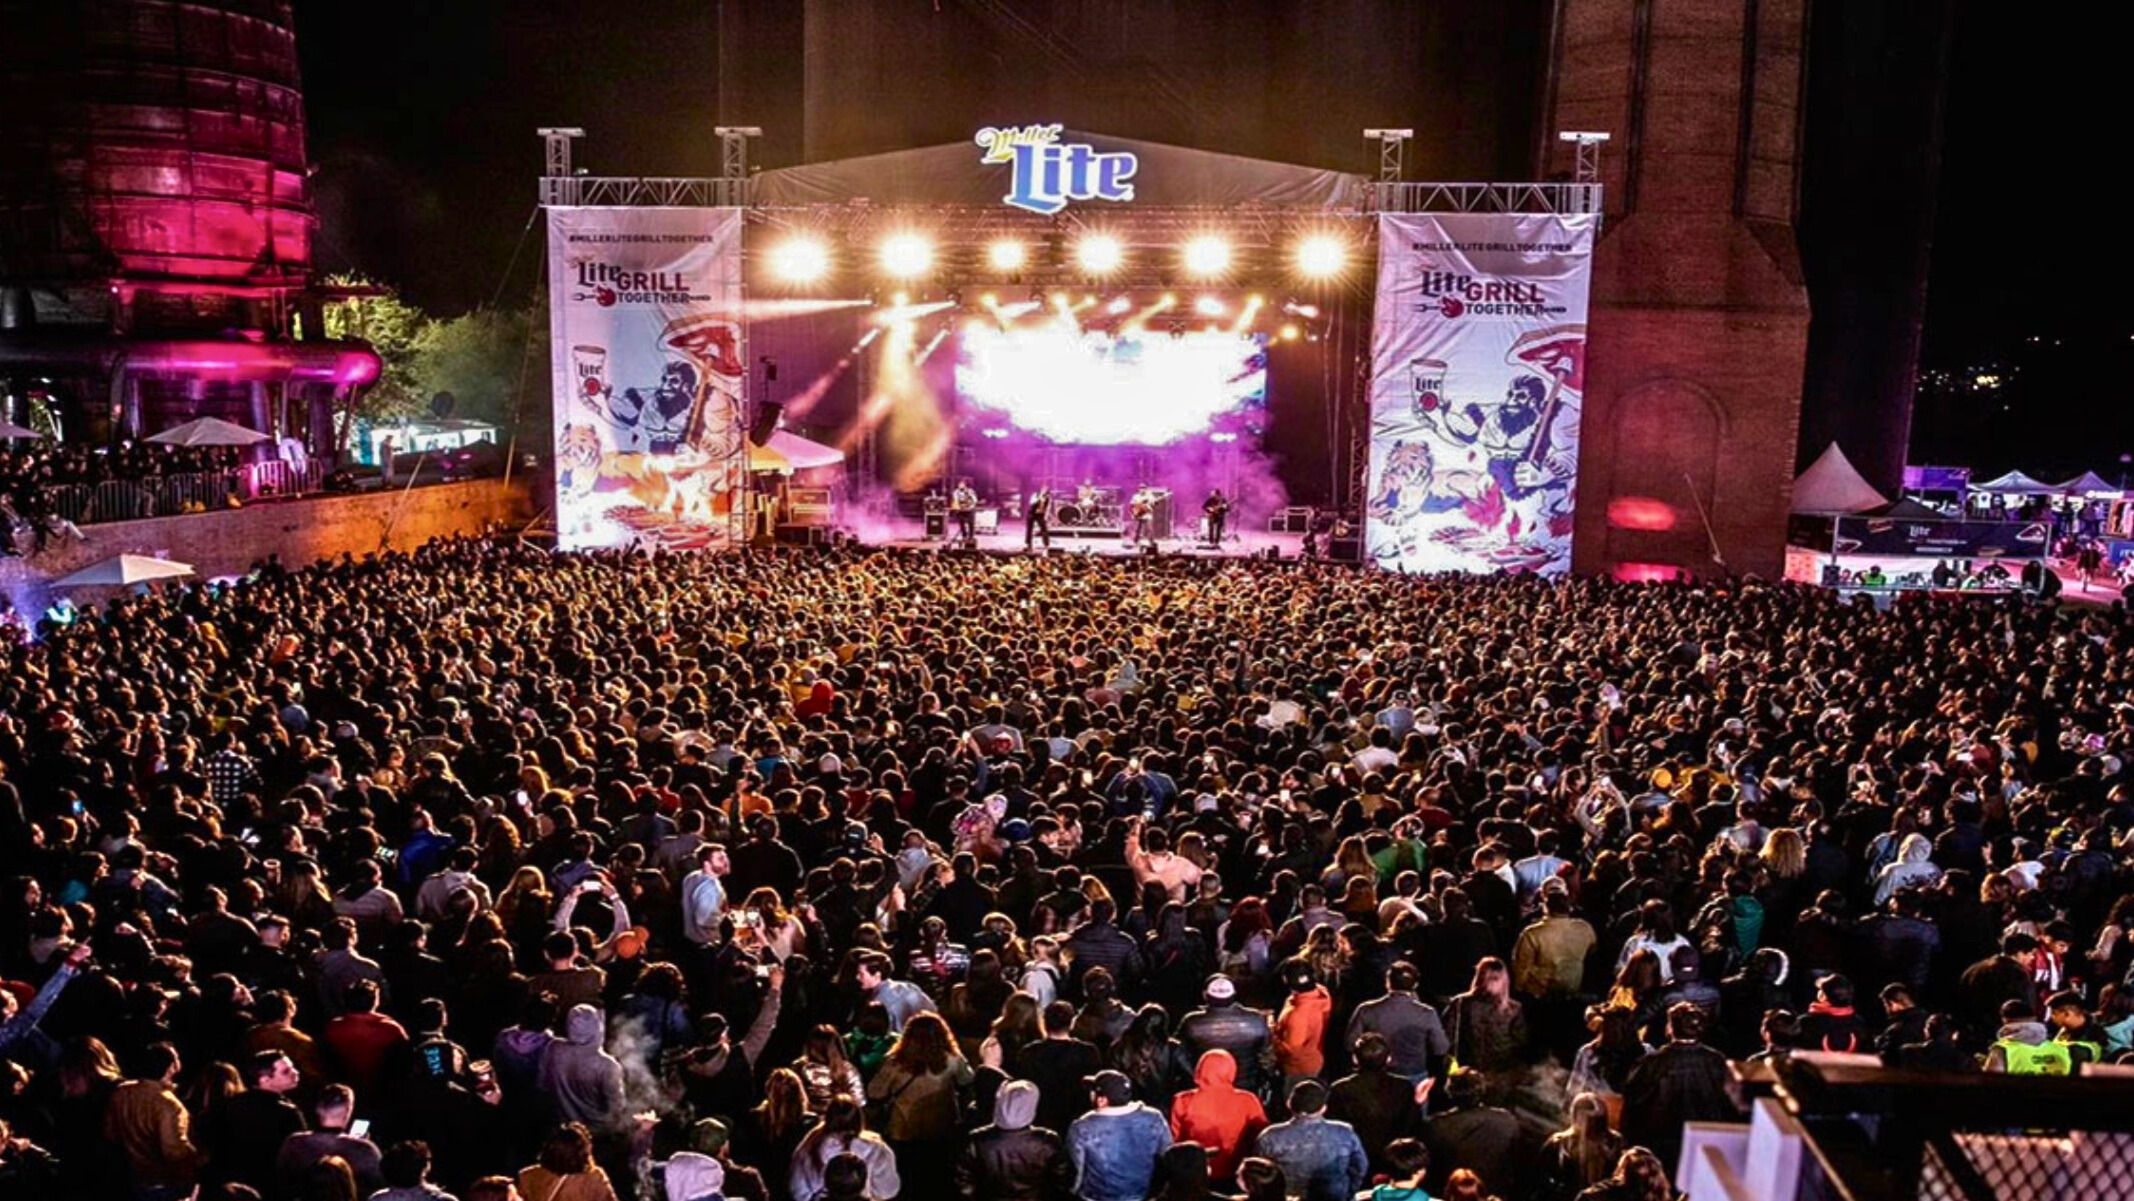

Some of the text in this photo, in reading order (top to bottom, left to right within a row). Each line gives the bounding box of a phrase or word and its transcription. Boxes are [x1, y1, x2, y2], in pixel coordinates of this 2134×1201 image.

[975, 123, 1064, 164] Miller
[1003, 143, 1138, 214] Lite
[577, 261, 622, 288] Lite
[616, 271, 690, 292] GRILL
[1421, 270, 1545, 304] Lite GRILL
[618, 291, 690, 304] TOGETHER
[1465, 303, 1544, 317] TOGETHER
